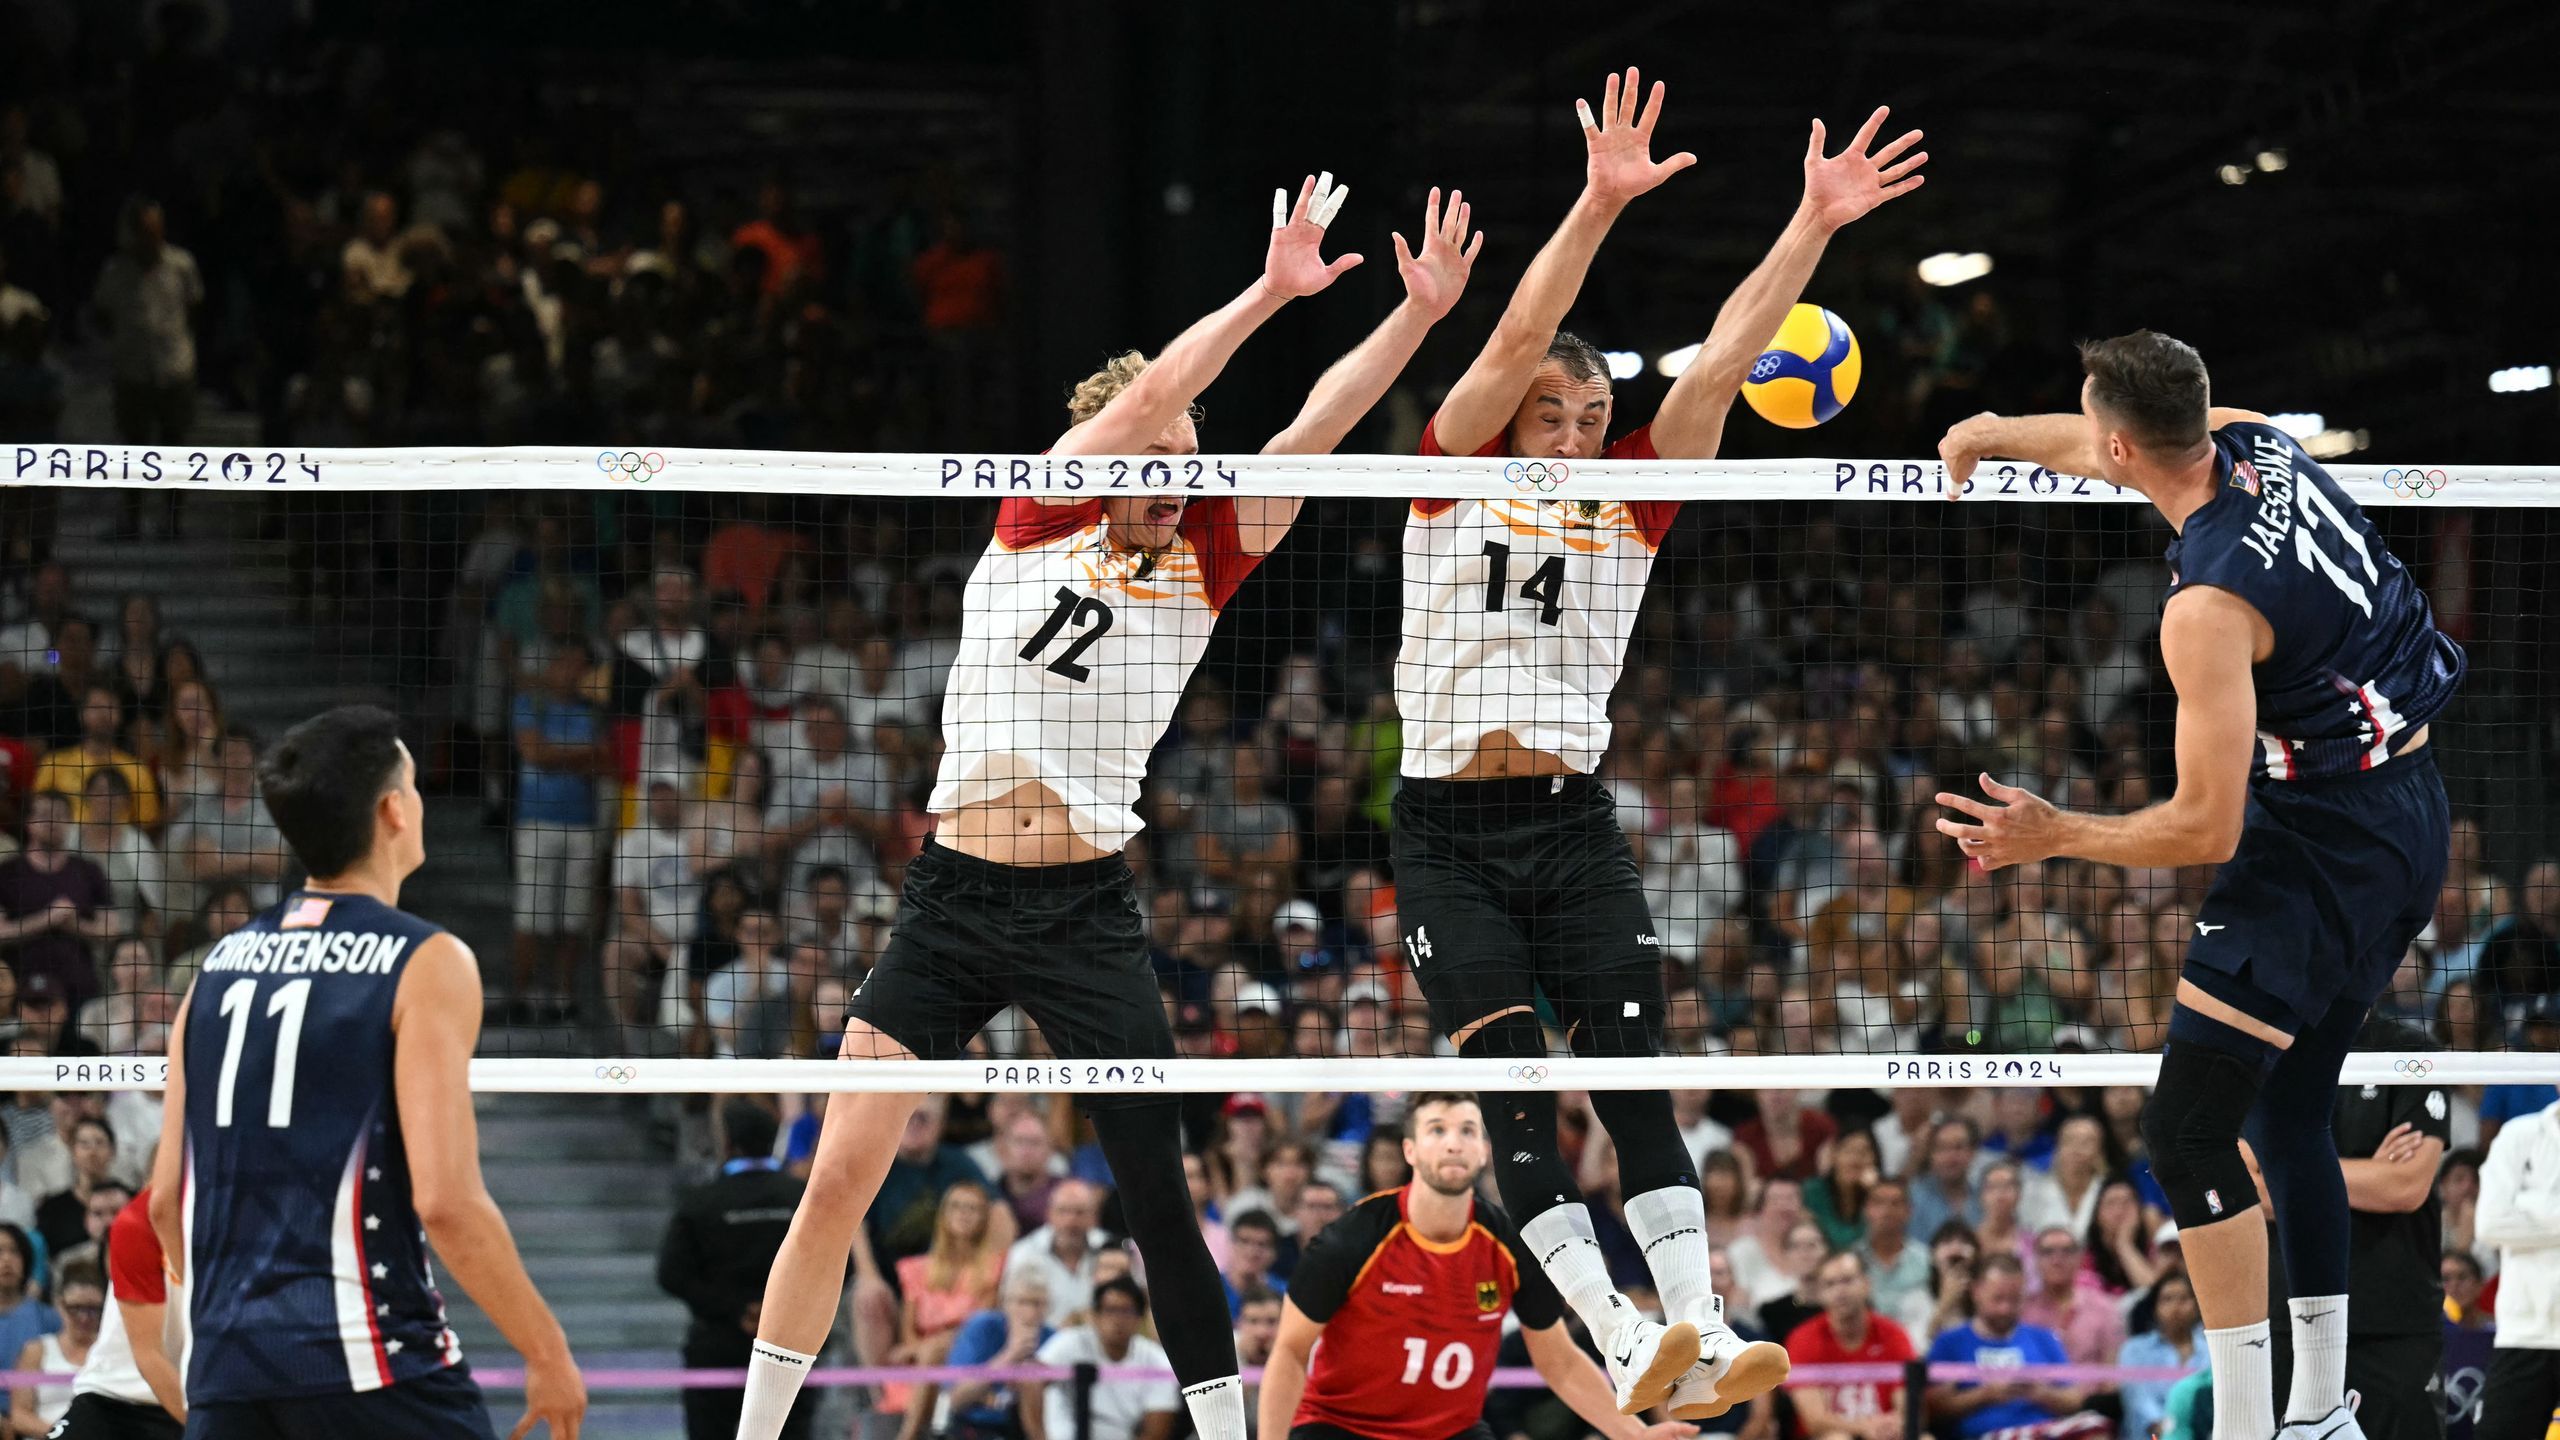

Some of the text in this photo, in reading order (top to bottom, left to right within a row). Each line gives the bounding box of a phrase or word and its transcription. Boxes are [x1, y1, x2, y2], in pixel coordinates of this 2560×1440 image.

[188, 452, 320, 483] 2024
[1108, 459, 1237, 490] 2024
[2242, 435, 2294, 571] JAESCHKE
[2294, 471, 2379, 620] 17
[1482, 540, 1566, 627] 14
[1018, 585, 1114, 684] 12
[202, 930, 409, 974] CHRISTENSON
[1405, 925, 1433, 968] 14
[215, 978, 312, 1128] 11
[1985, 1060, 2062, 1079] 2024
[1086, 1066, 1165, 1084] 2024
[1607, 1294, 1623, 1309] NIKE
[1713, 1296, 1721, 1313] NIKE
[1401, 1337, 1474, 1390] 10
